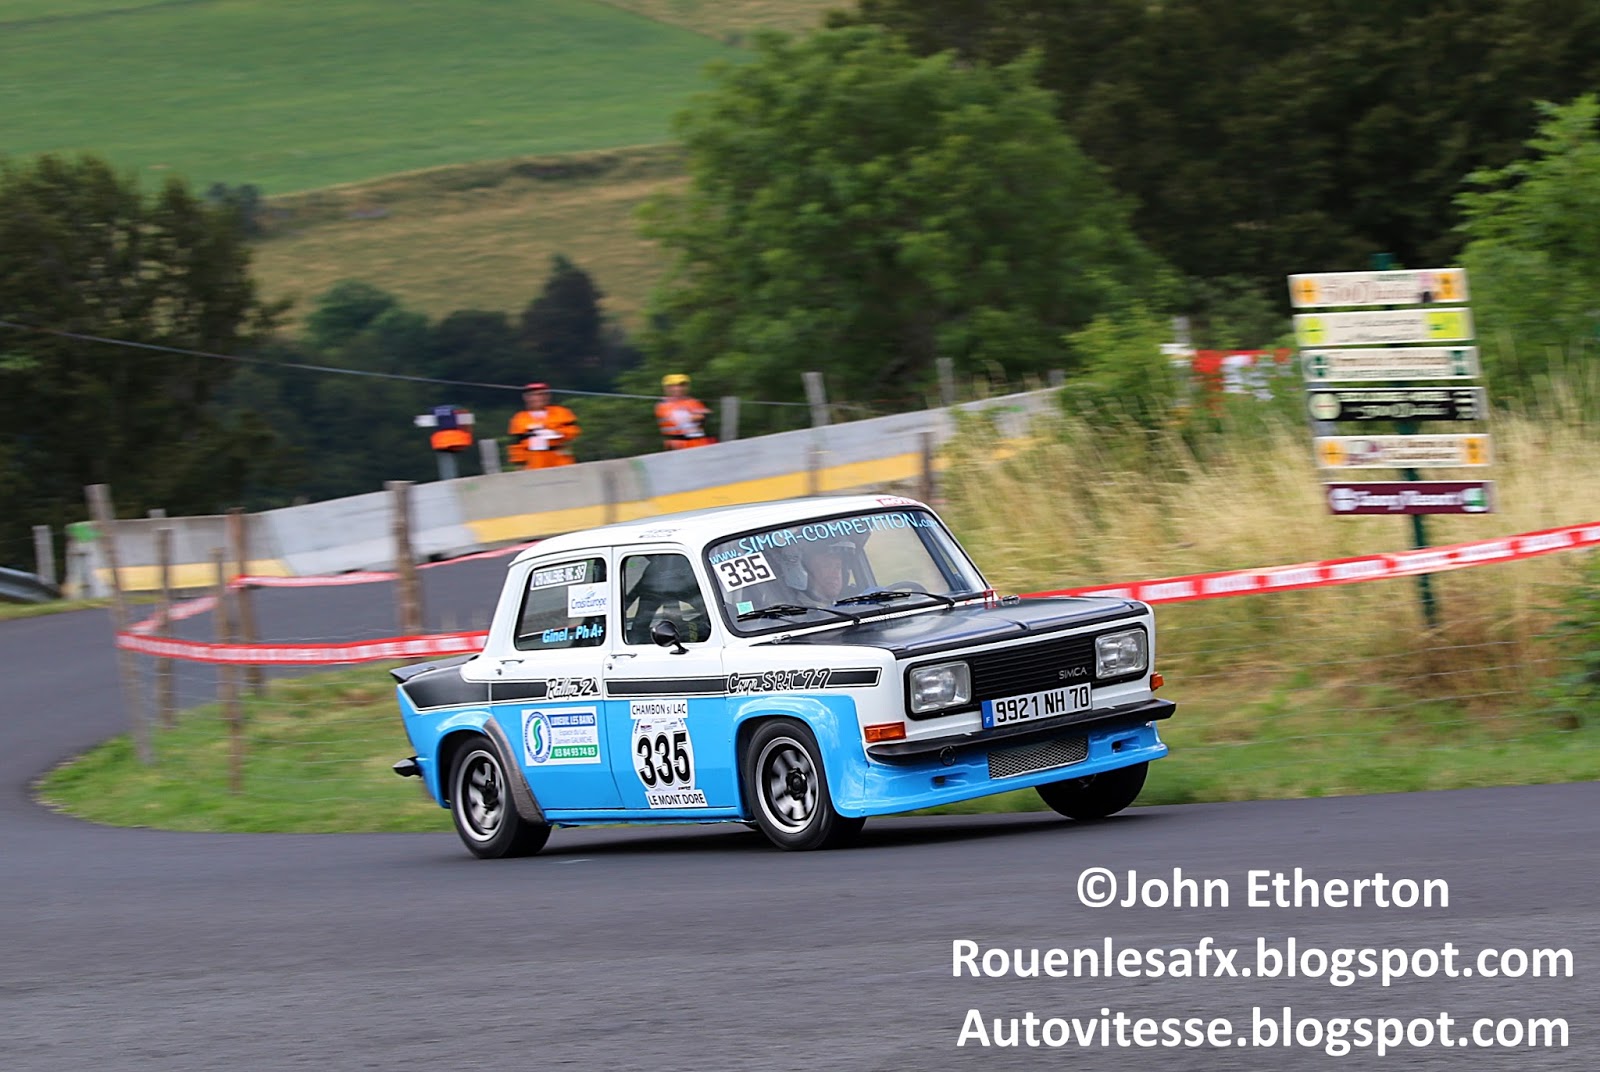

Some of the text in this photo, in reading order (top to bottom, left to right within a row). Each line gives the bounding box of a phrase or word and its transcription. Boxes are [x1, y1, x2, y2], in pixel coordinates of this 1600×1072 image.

[709, 512, 940, 565] www.SIMCA-COMPETITION.com
[720, 555, 770, 587] 335
[542, 627, 568, 643] Ginel
[802, 668, 831, 689] 77
[1058, 667, 1088, 680] SIMCA
[632, 704, 665, 715] CHAMBON
[673, 703, 686, 714] LAC
[996, 686, 1089, 723] 9921 NH 70
[637, 730, 691, 788] 335
[648, 793, 706, 805] LE MONT DORE
